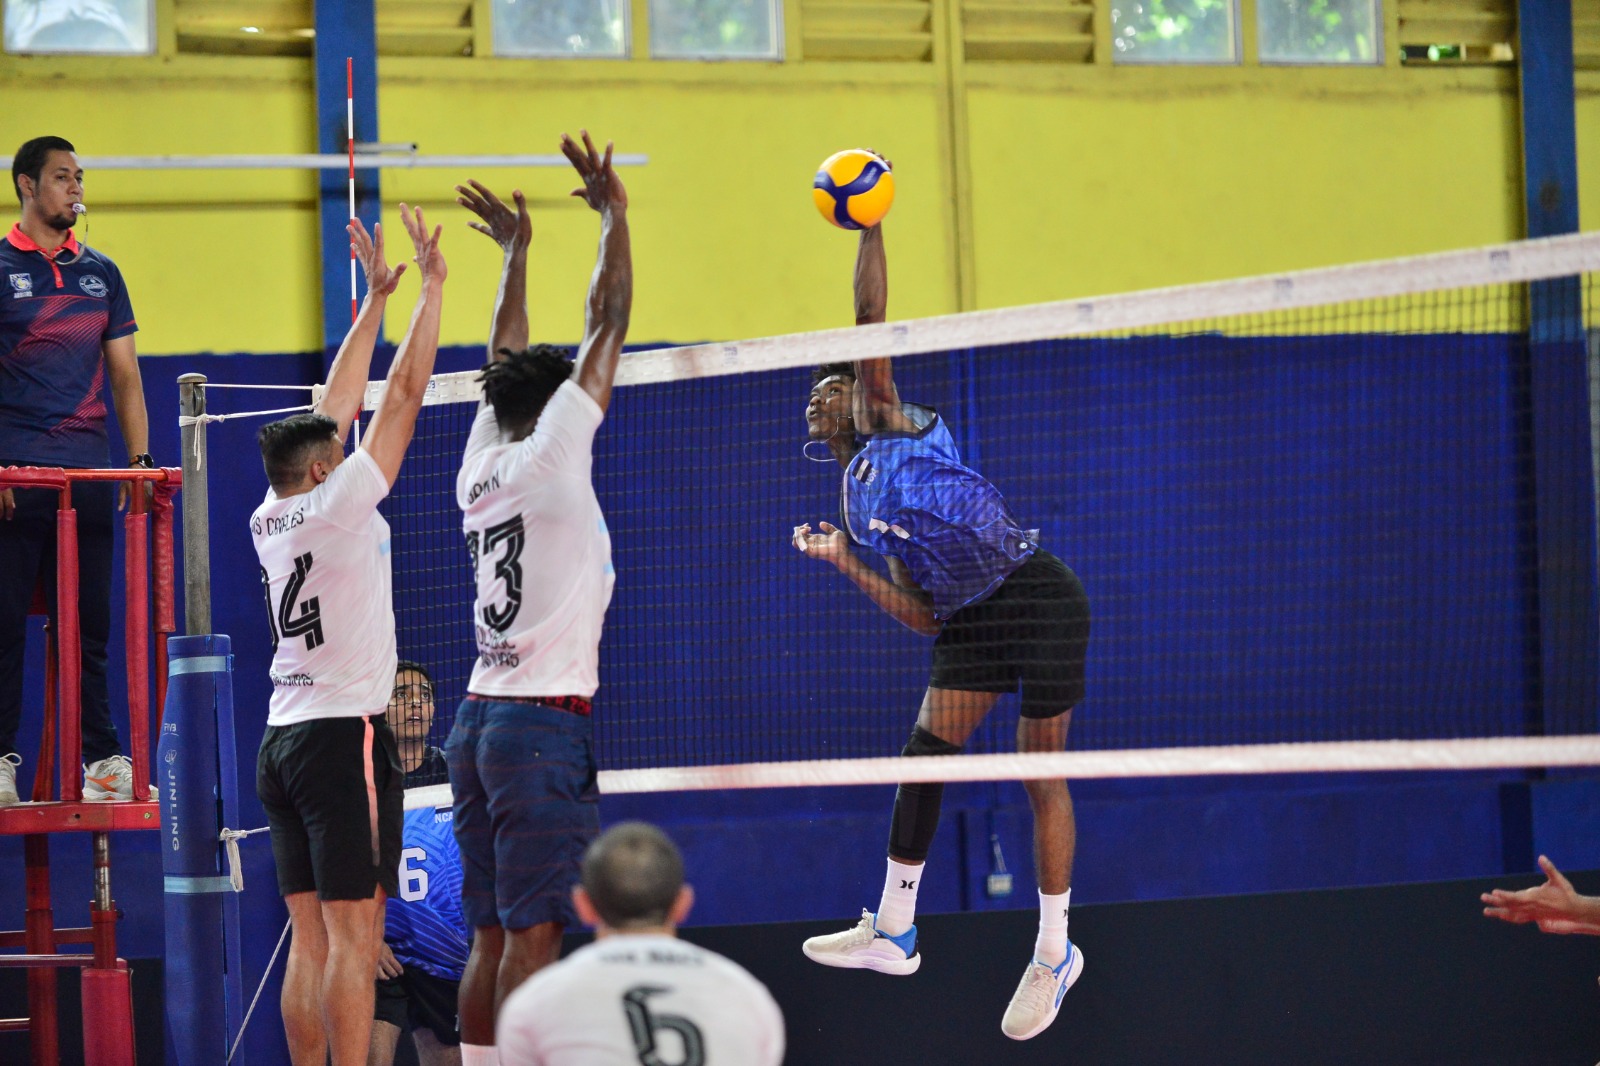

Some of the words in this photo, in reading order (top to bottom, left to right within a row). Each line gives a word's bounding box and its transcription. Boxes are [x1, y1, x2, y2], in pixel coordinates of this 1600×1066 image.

[168, 769, 180, 851] JINLING
[397, 846, 429, 902] 6
[623, 985, 706, 1066] 6
